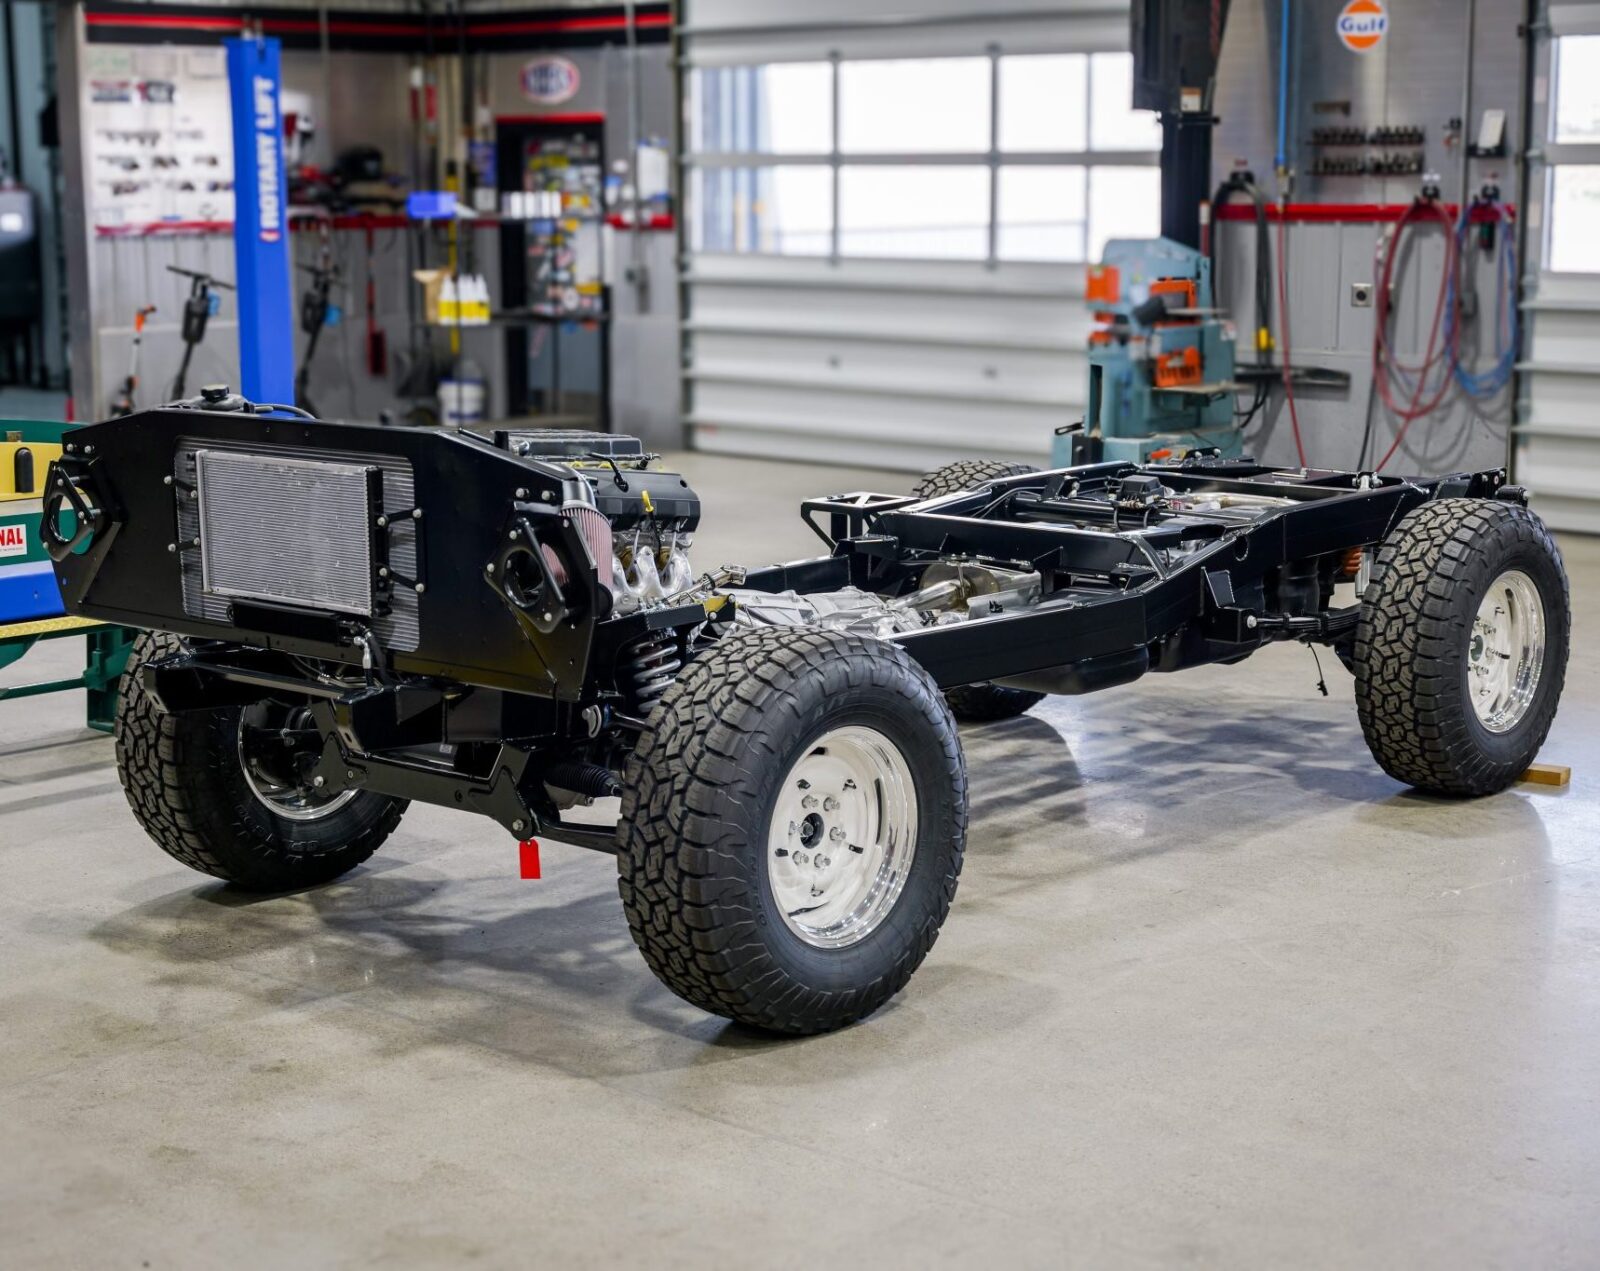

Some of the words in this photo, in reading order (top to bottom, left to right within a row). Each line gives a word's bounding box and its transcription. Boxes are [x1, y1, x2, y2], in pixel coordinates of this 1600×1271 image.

[1341, 16, 1385, 32] Gulf
[253, 75, 276, 129] LIFT
[256, 132, 280, 229] ROTARY
